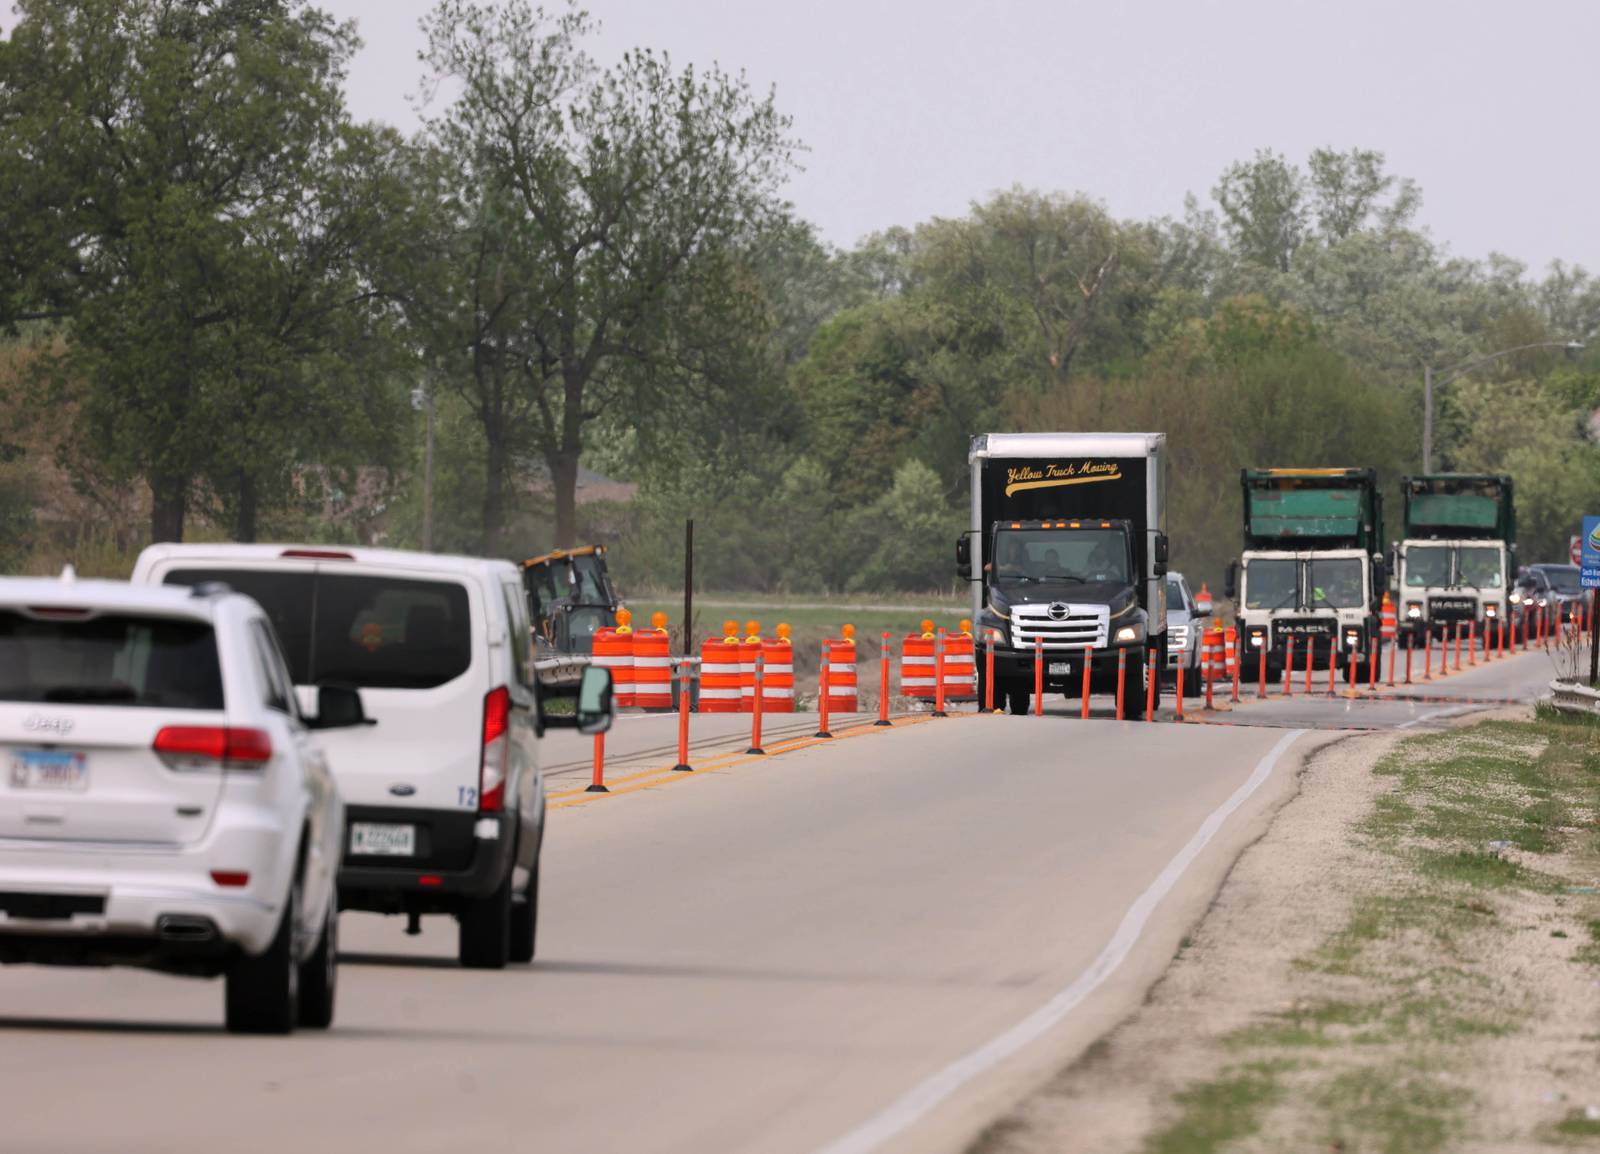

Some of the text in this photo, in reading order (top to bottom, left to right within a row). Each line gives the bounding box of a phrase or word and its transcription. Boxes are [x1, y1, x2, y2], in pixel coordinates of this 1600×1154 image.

[1007, 460, 1118, 484] Yellow Truck Moving
[1431, 600, 1472, 609] MACK
[1278, 625, 1330, 633] MACK
[457, 785, 477, 807] T2
